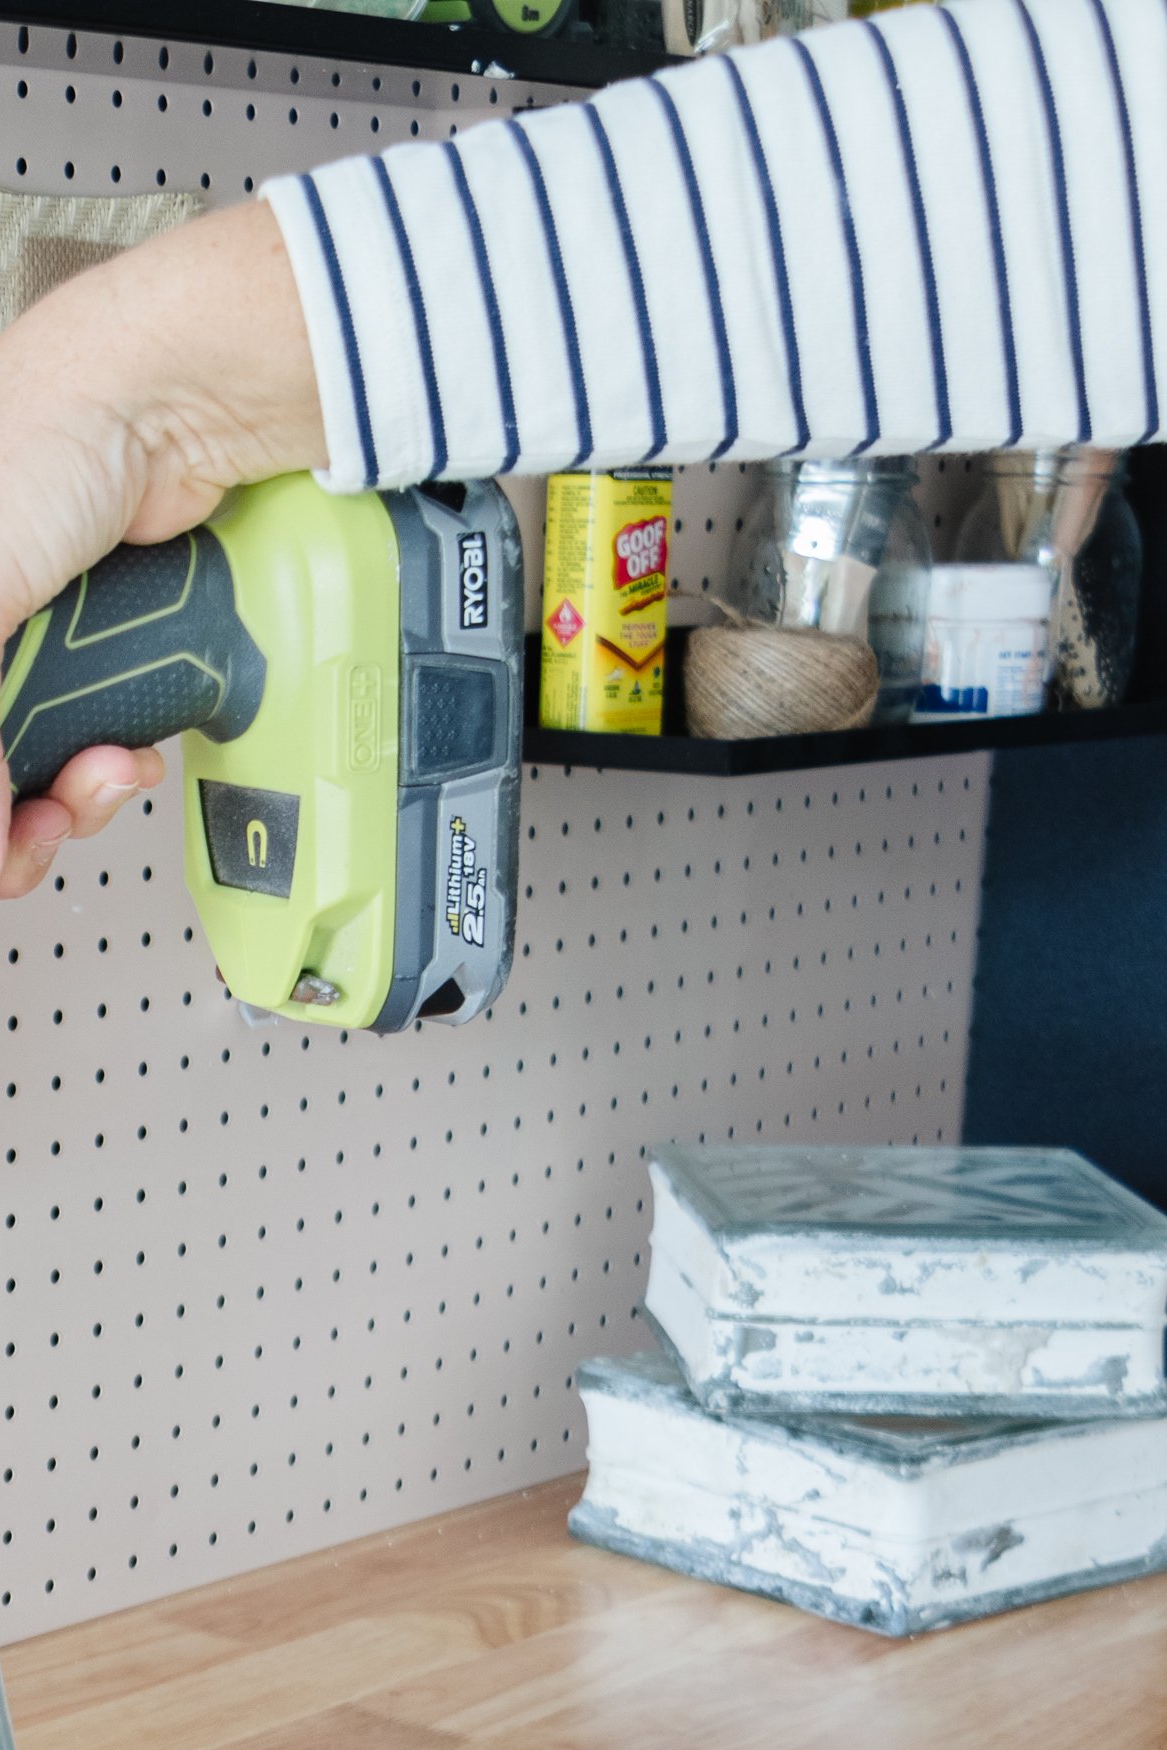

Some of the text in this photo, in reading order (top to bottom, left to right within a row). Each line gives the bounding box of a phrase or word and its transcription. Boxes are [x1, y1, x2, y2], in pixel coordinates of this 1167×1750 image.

[616, 519, 665, 559] GOOF
[462, 538, 484, 627] RYOBI
[626, 546, 661, 579] OFF
[462, 834, 477, 878] 18V
